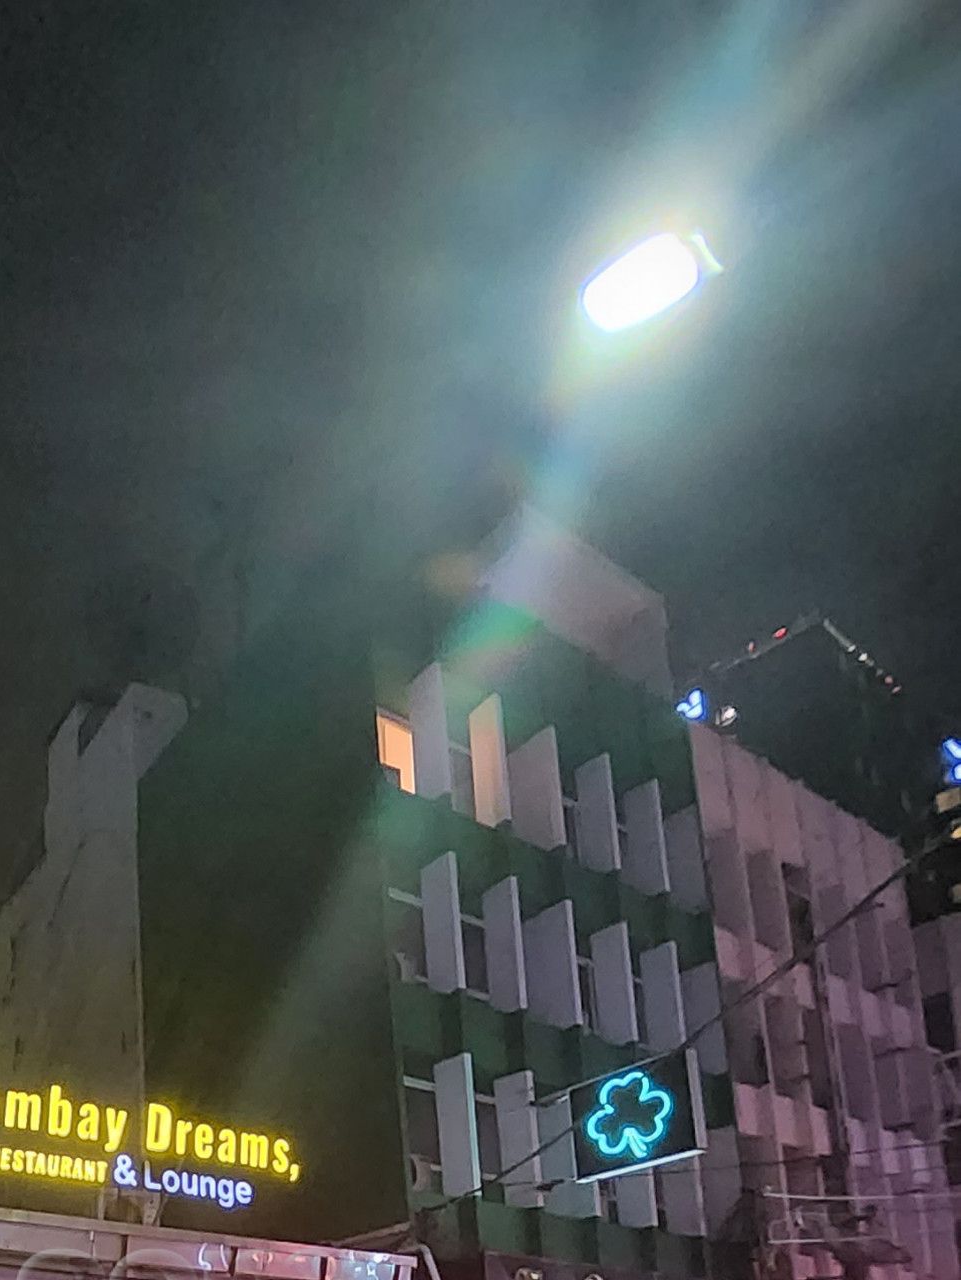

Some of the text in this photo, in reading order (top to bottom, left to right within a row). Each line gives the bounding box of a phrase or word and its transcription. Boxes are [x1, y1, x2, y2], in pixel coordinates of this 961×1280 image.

[145, 1102, 301, 1183] Dreams,
[114, 1154, 138, 1187] &
[144, 1160, 253, 1208] Lounge
